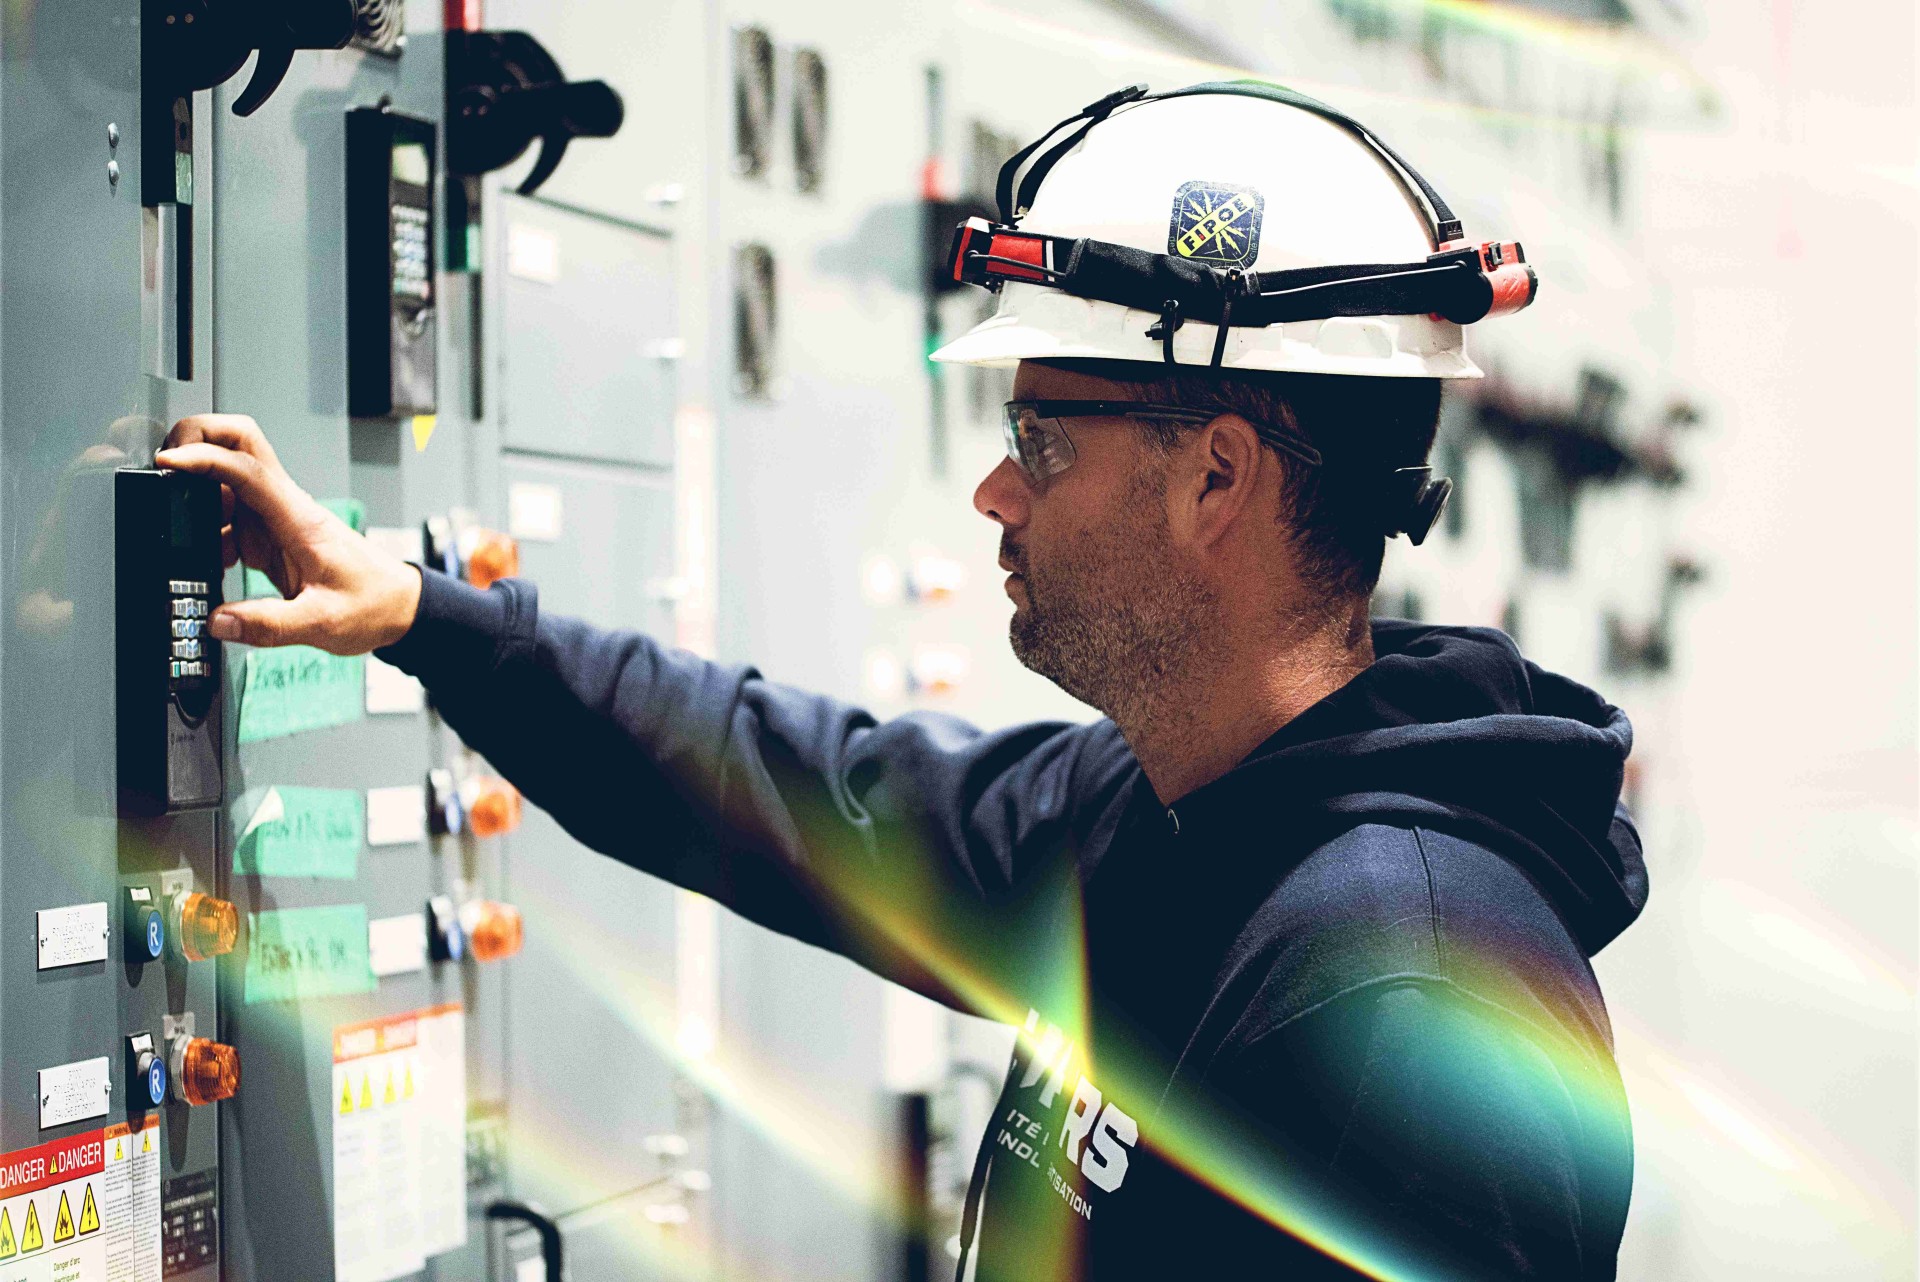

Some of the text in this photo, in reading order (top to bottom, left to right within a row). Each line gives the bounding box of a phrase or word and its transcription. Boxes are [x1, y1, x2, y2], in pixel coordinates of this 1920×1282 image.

[1182, 198, 1248, 252] FIPOE
[150, 921, 159, 947] R
[152, 1068, 161, 1095] R
[0, 1157, 45, 1189] DANGER
[59, 1141, 101, 1174] DANGER
